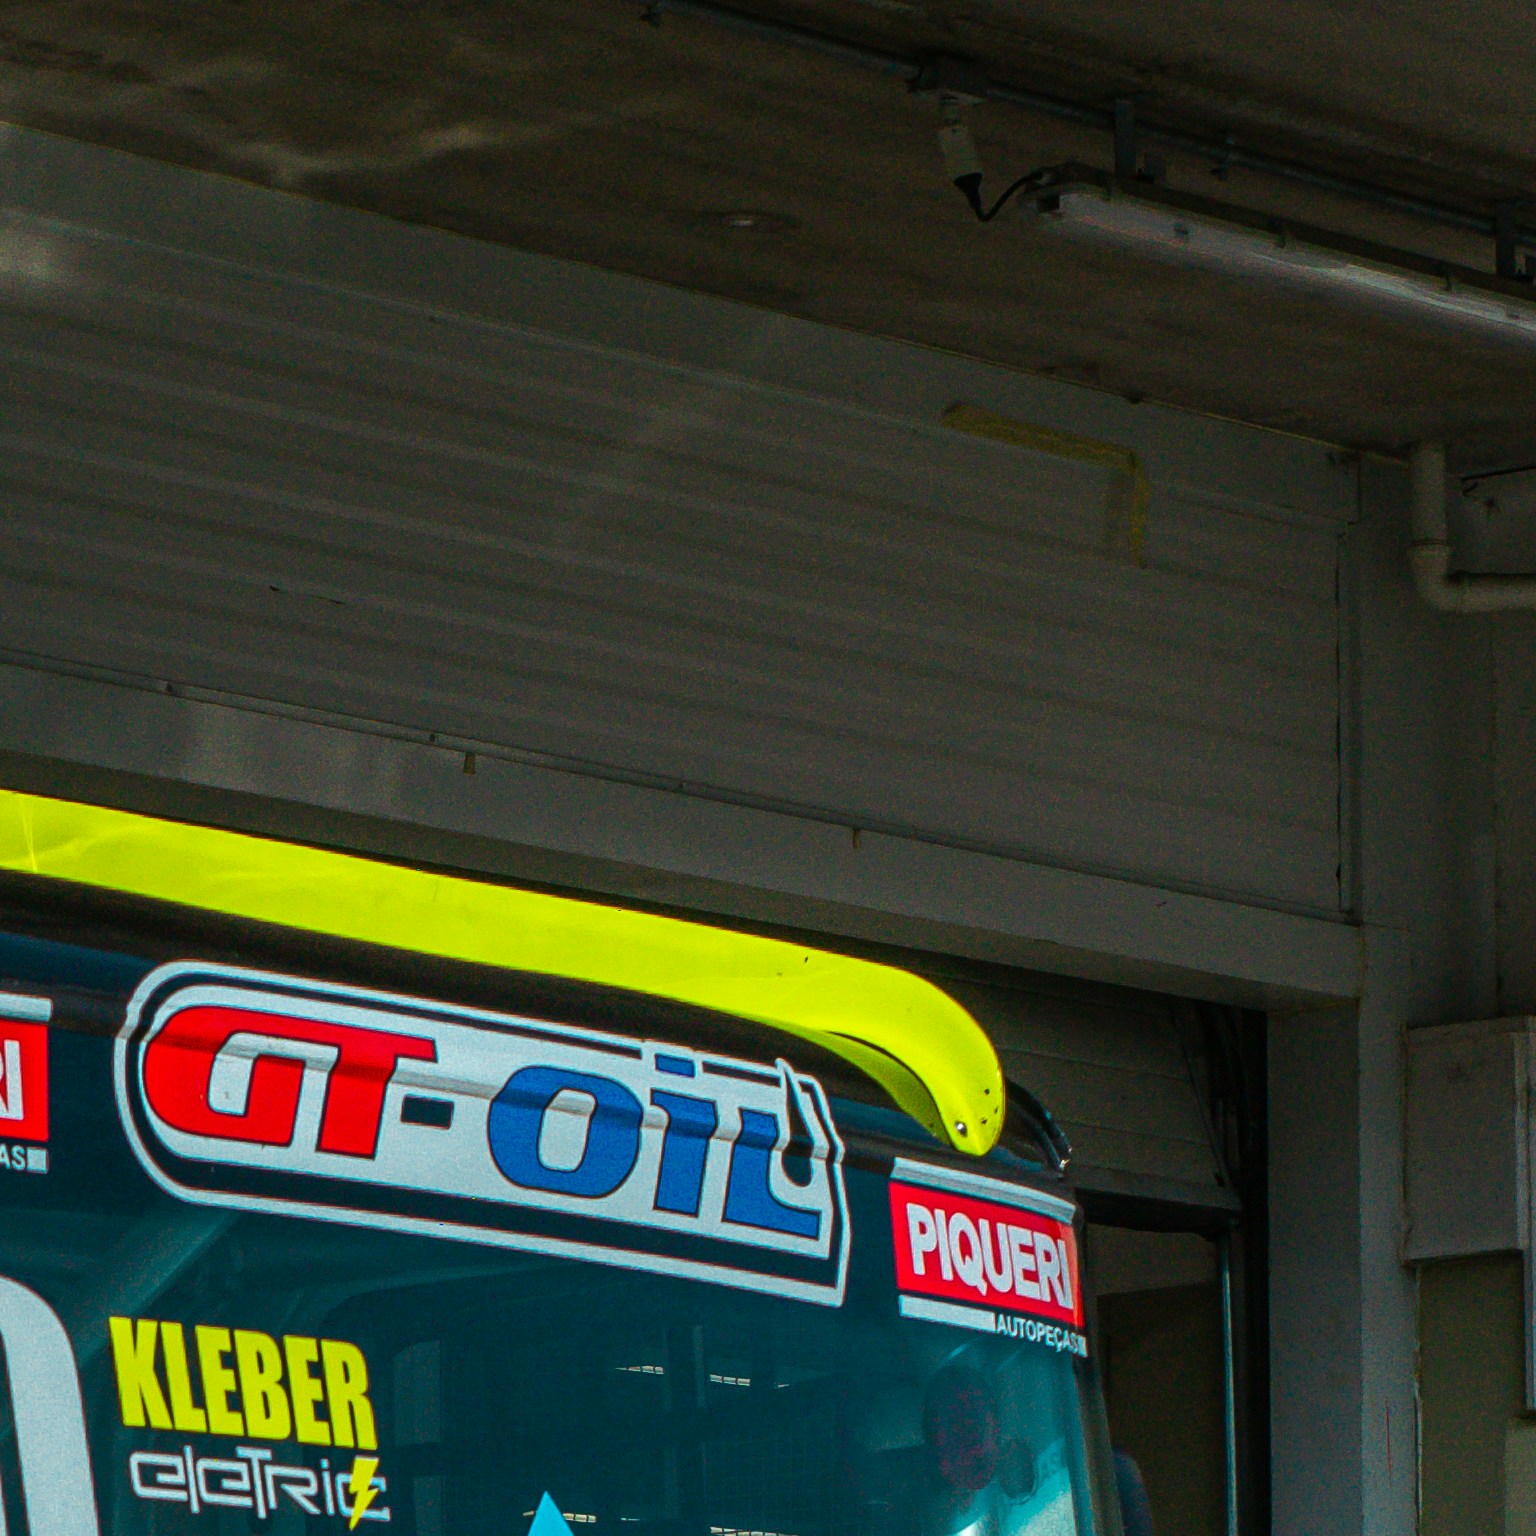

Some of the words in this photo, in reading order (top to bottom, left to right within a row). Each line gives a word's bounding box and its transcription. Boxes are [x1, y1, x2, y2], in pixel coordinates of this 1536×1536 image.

[906, 1202, 1074, 1310] PIQUERI
[108, 1316, 378, 1451] KLEBER
[996, 1312, 1078, 1353] AUTOPEÇAS
